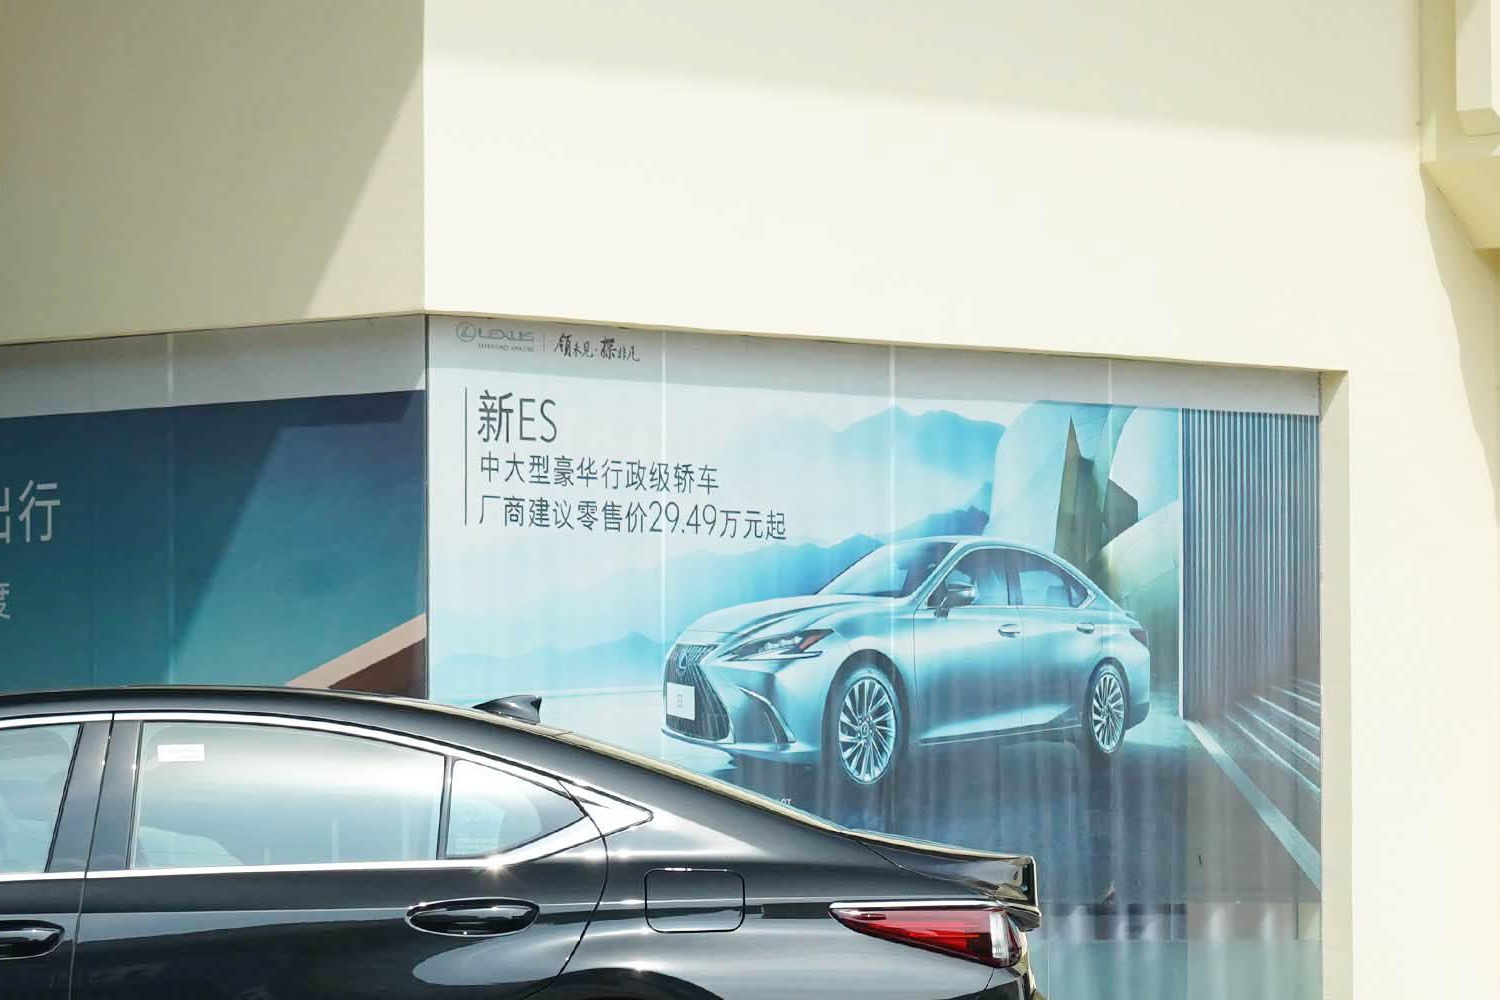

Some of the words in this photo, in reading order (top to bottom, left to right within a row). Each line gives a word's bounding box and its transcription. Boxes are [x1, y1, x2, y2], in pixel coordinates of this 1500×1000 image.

[478, 327, 535, 343] LEXUS
[477, 389, 558, 444] 新ES
[480, 450, 720, 496] 中大型豪华行政级轿车
[479, 494, 787, 541] 厂商建议零售价29.49万元起
